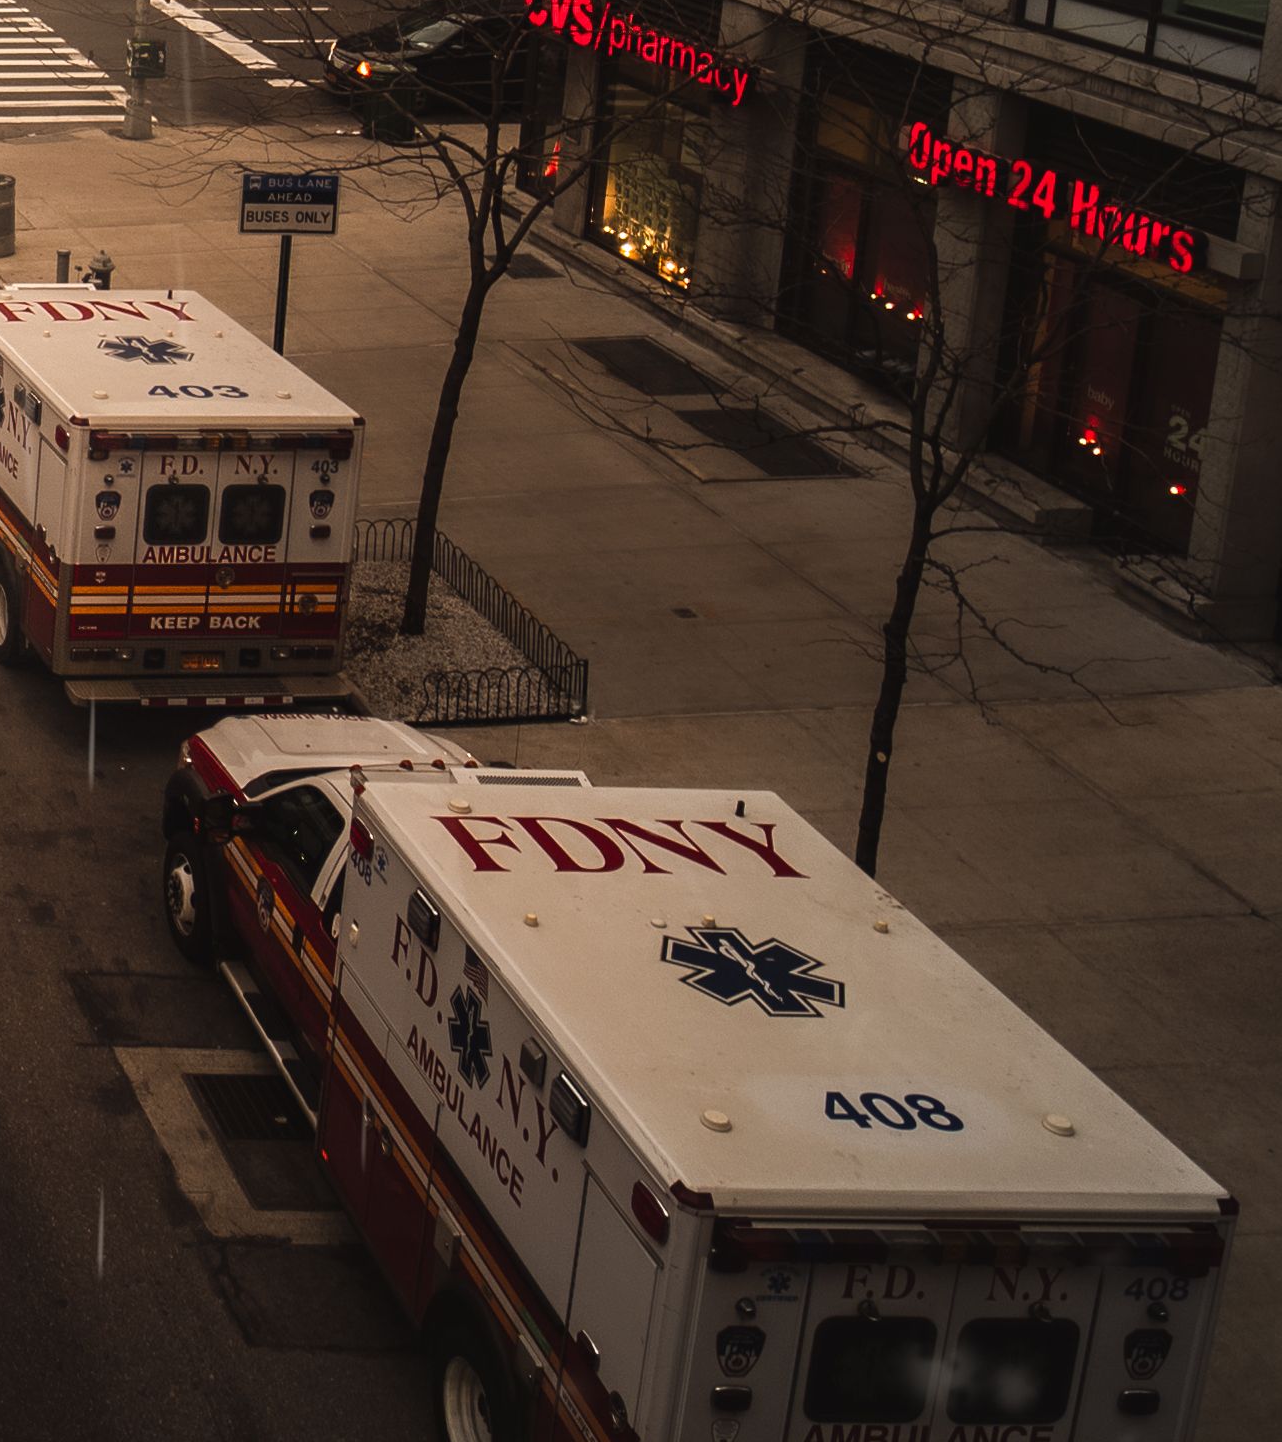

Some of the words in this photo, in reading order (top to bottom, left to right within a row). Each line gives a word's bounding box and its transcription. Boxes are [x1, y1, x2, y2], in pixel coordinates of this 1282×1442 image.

[268, 178, 293, 188] BUS
[297, 178, 332, 189] LANE
[267, 193, 312, 202] AHEAD
[908, 121, 997, 198] Open
[1006, 158, 1057, 219] 24
[1069, 177, 1195, 274] Hours
[245, 210, 289, 223] BUSES
[295, 210, 331, 224] ONLY
[148, 385, 250, 399] 403
[1087, 384, 1116, 411] baby
[160, 455, 204, 476] F.D.
[234, 455, 278, 475] N.Y.
[311, 460, 340, 474] 403
[143, 546, 276, 563] AMBULANCE
[150, 616, 201, 630] KEEP
[209, 616, 261, 630] BACK
[429, 816, 811, 879] FDNY
[351, 849, 372, 886] 408
[391, 914, 443, 1024] F.D.
[496, 1053, 559, 1183] N.Y.
[407, 1025, 524, 1209] AMBULANCE
[823, 1090, 965, 1132] 408
[841, 1264, 925, 1299] F.D.
[986, 1266, 1069, 1302] N.Y.
[1124, 1277, 1189, 1301] 408
